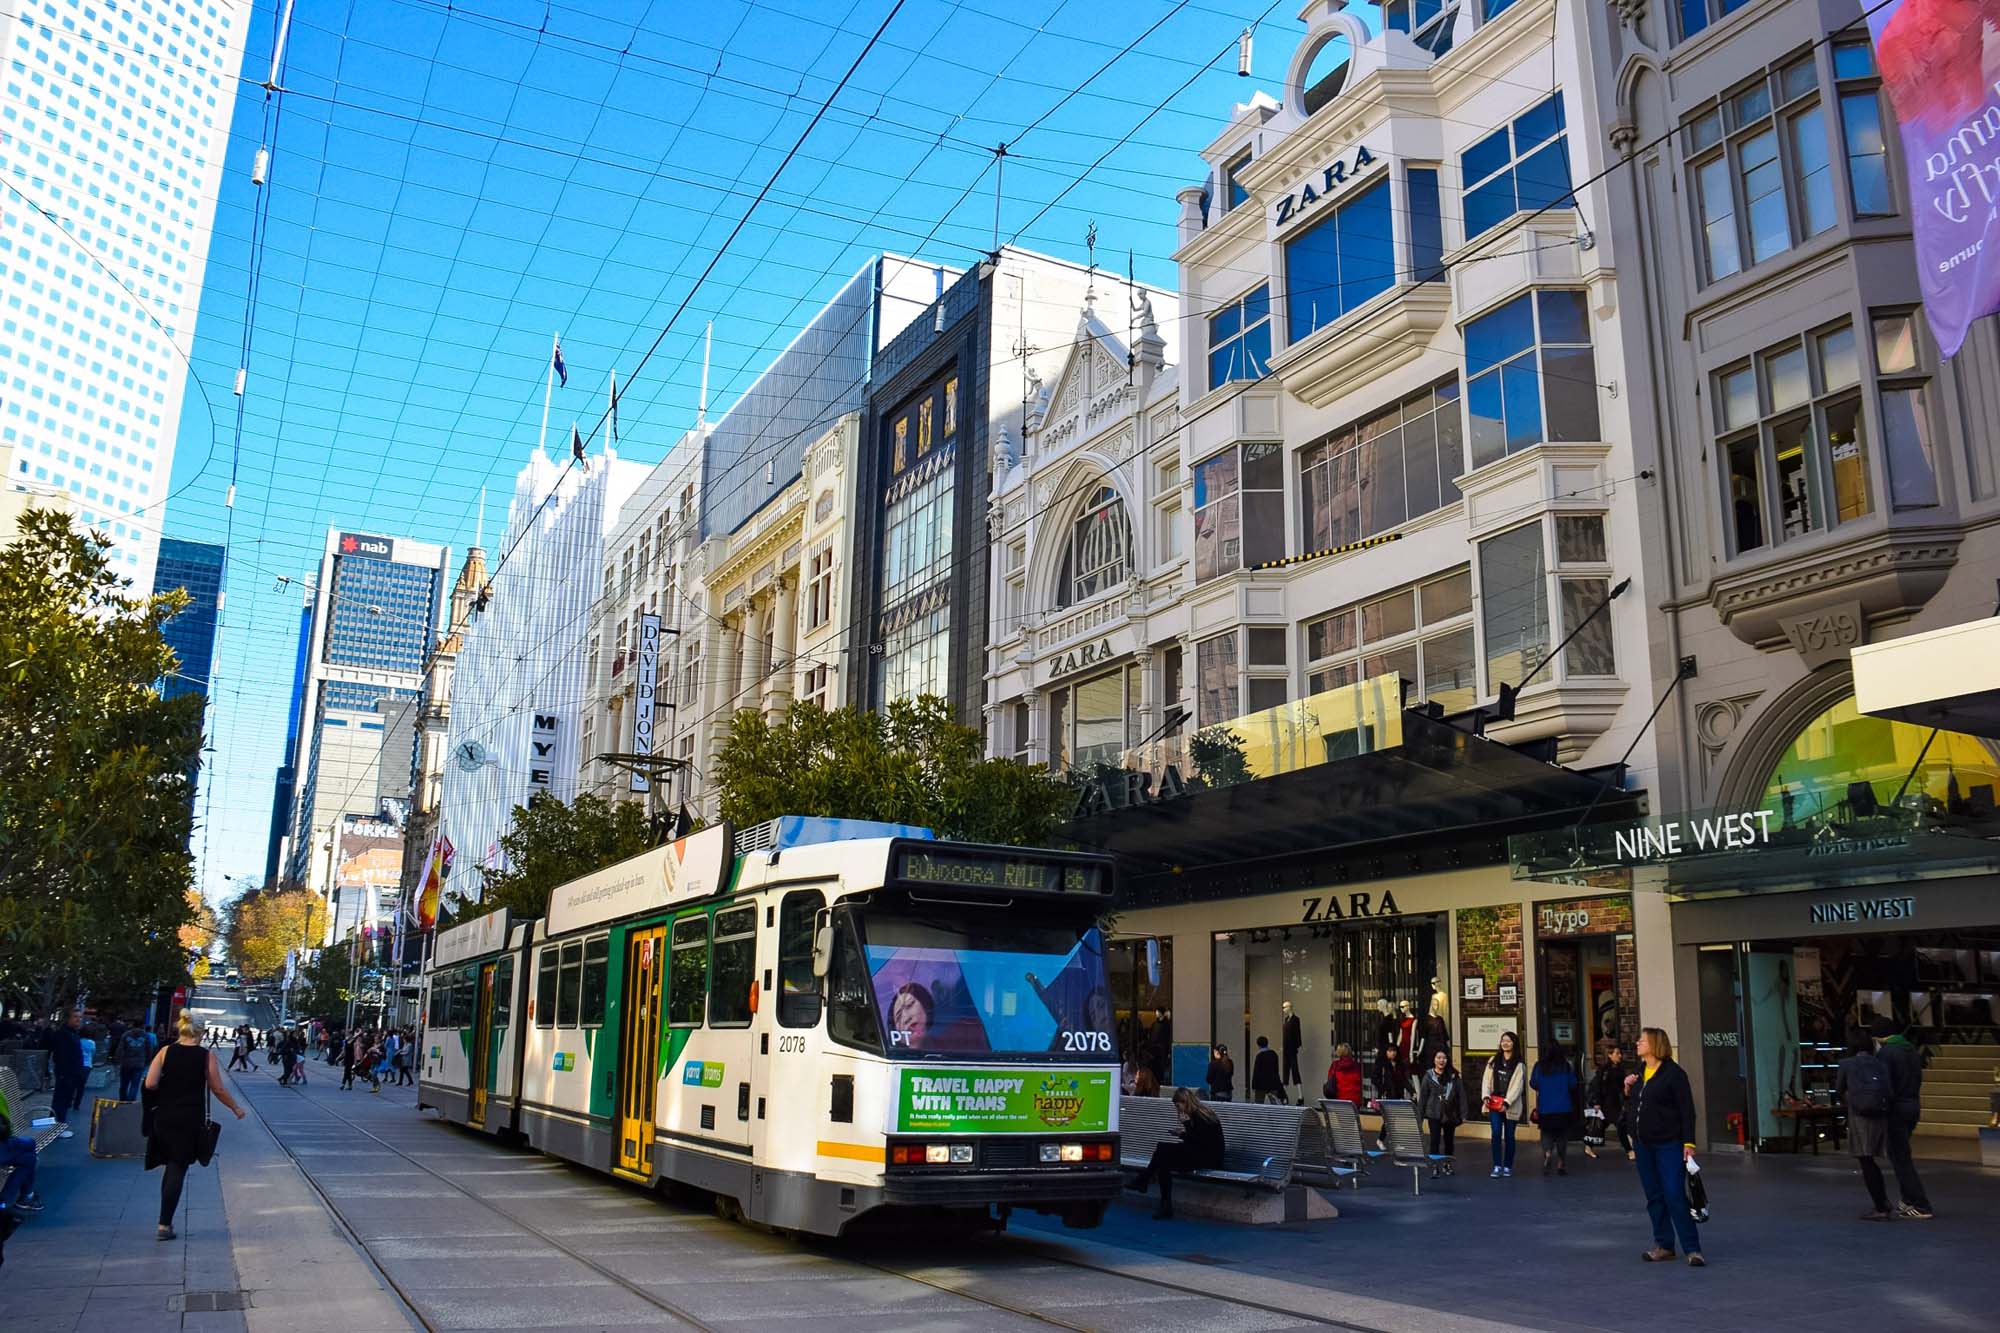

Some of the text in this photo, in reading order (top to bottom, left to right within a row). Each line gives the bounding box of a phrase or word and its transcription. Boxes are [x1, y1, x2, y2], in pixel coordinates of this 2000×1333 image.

[1276, 145, 1377, 227] ZARA
[360, 541, 389, 555] nab
[1791, 613, 1858, 655] 1849
[639, 625, 658, 699] DAVID
[870, 644, 883, 655] 39
[1049, 638, 1114, 678] ZARA
[528, 715, 556, 809] MYE
[1615, 822, 1682, 861] NINE
[1690, 809, 1774, 852] WEST
[907, 855, 995, 885] BUNDOORA
[1004, 863, 1046, 888] RMIT
[1302, 890, 1402, 922] ZARA
[1810, 896, 1916, 924] NINE WEST
[1542, 908, 1590, 933] Typo
[779, 1036, 806, 1054] 2078
[890, 1030, 912, 1047] PT
[1061, 1031, 1112, 1052] 2078
[1703, 1032, 1721, 1042] NINE
[911, 1076, 1025, 1094] TRAVEL HAPPY
[911, 1094, 1007, 1111] WITH TRAMS
[1034, 1093, 1085, 1114] happy
